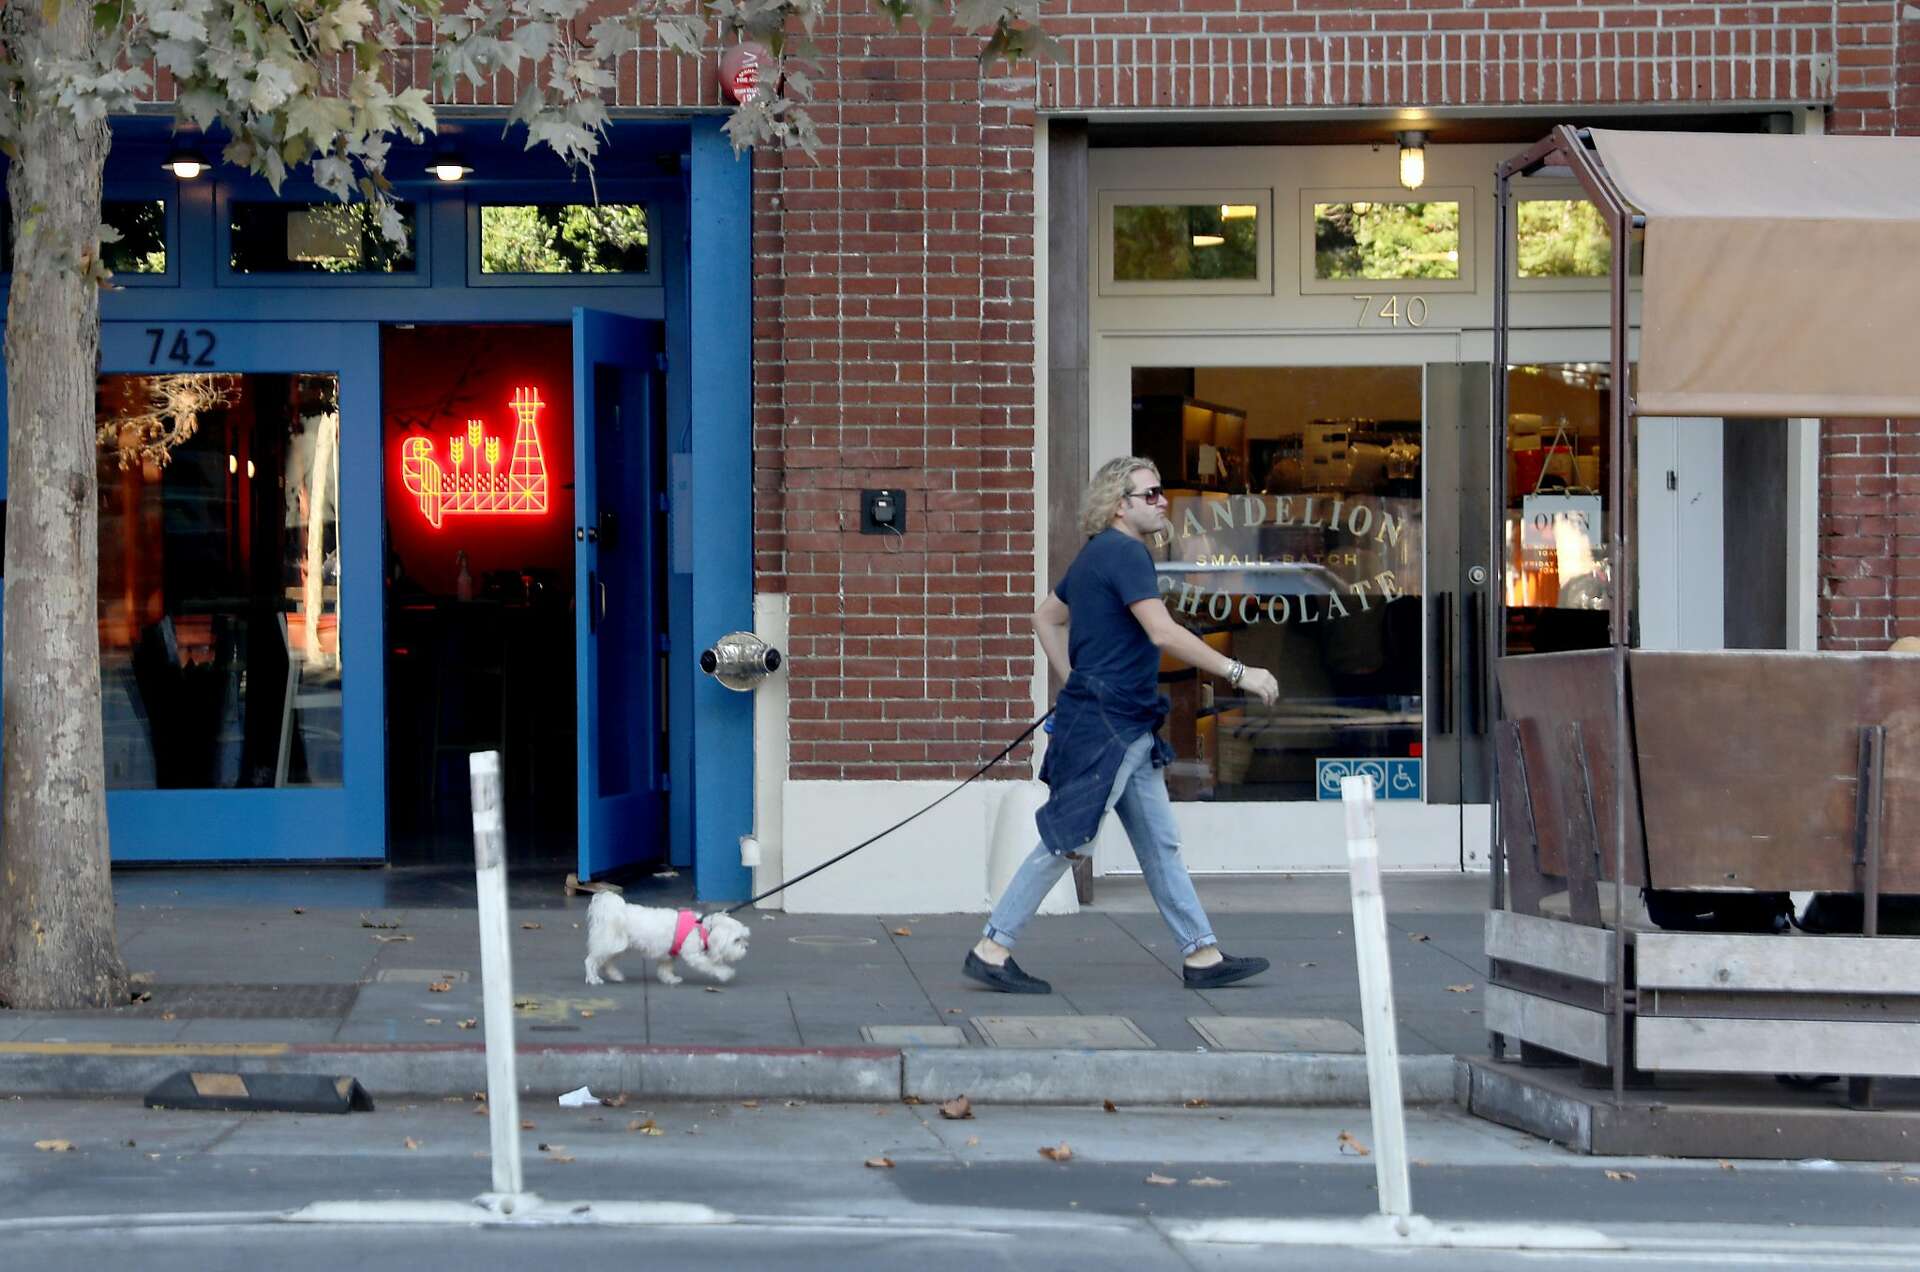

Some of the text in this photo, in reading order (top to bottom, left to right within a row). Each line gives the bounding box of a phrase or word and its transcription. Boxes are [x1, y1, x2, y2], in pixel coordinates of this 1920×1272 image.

[1353, 295, 1428, 328] 740
[146, 328, 216, 367] 742
[1196, 553, 1358, 566] SMALL BATCH
